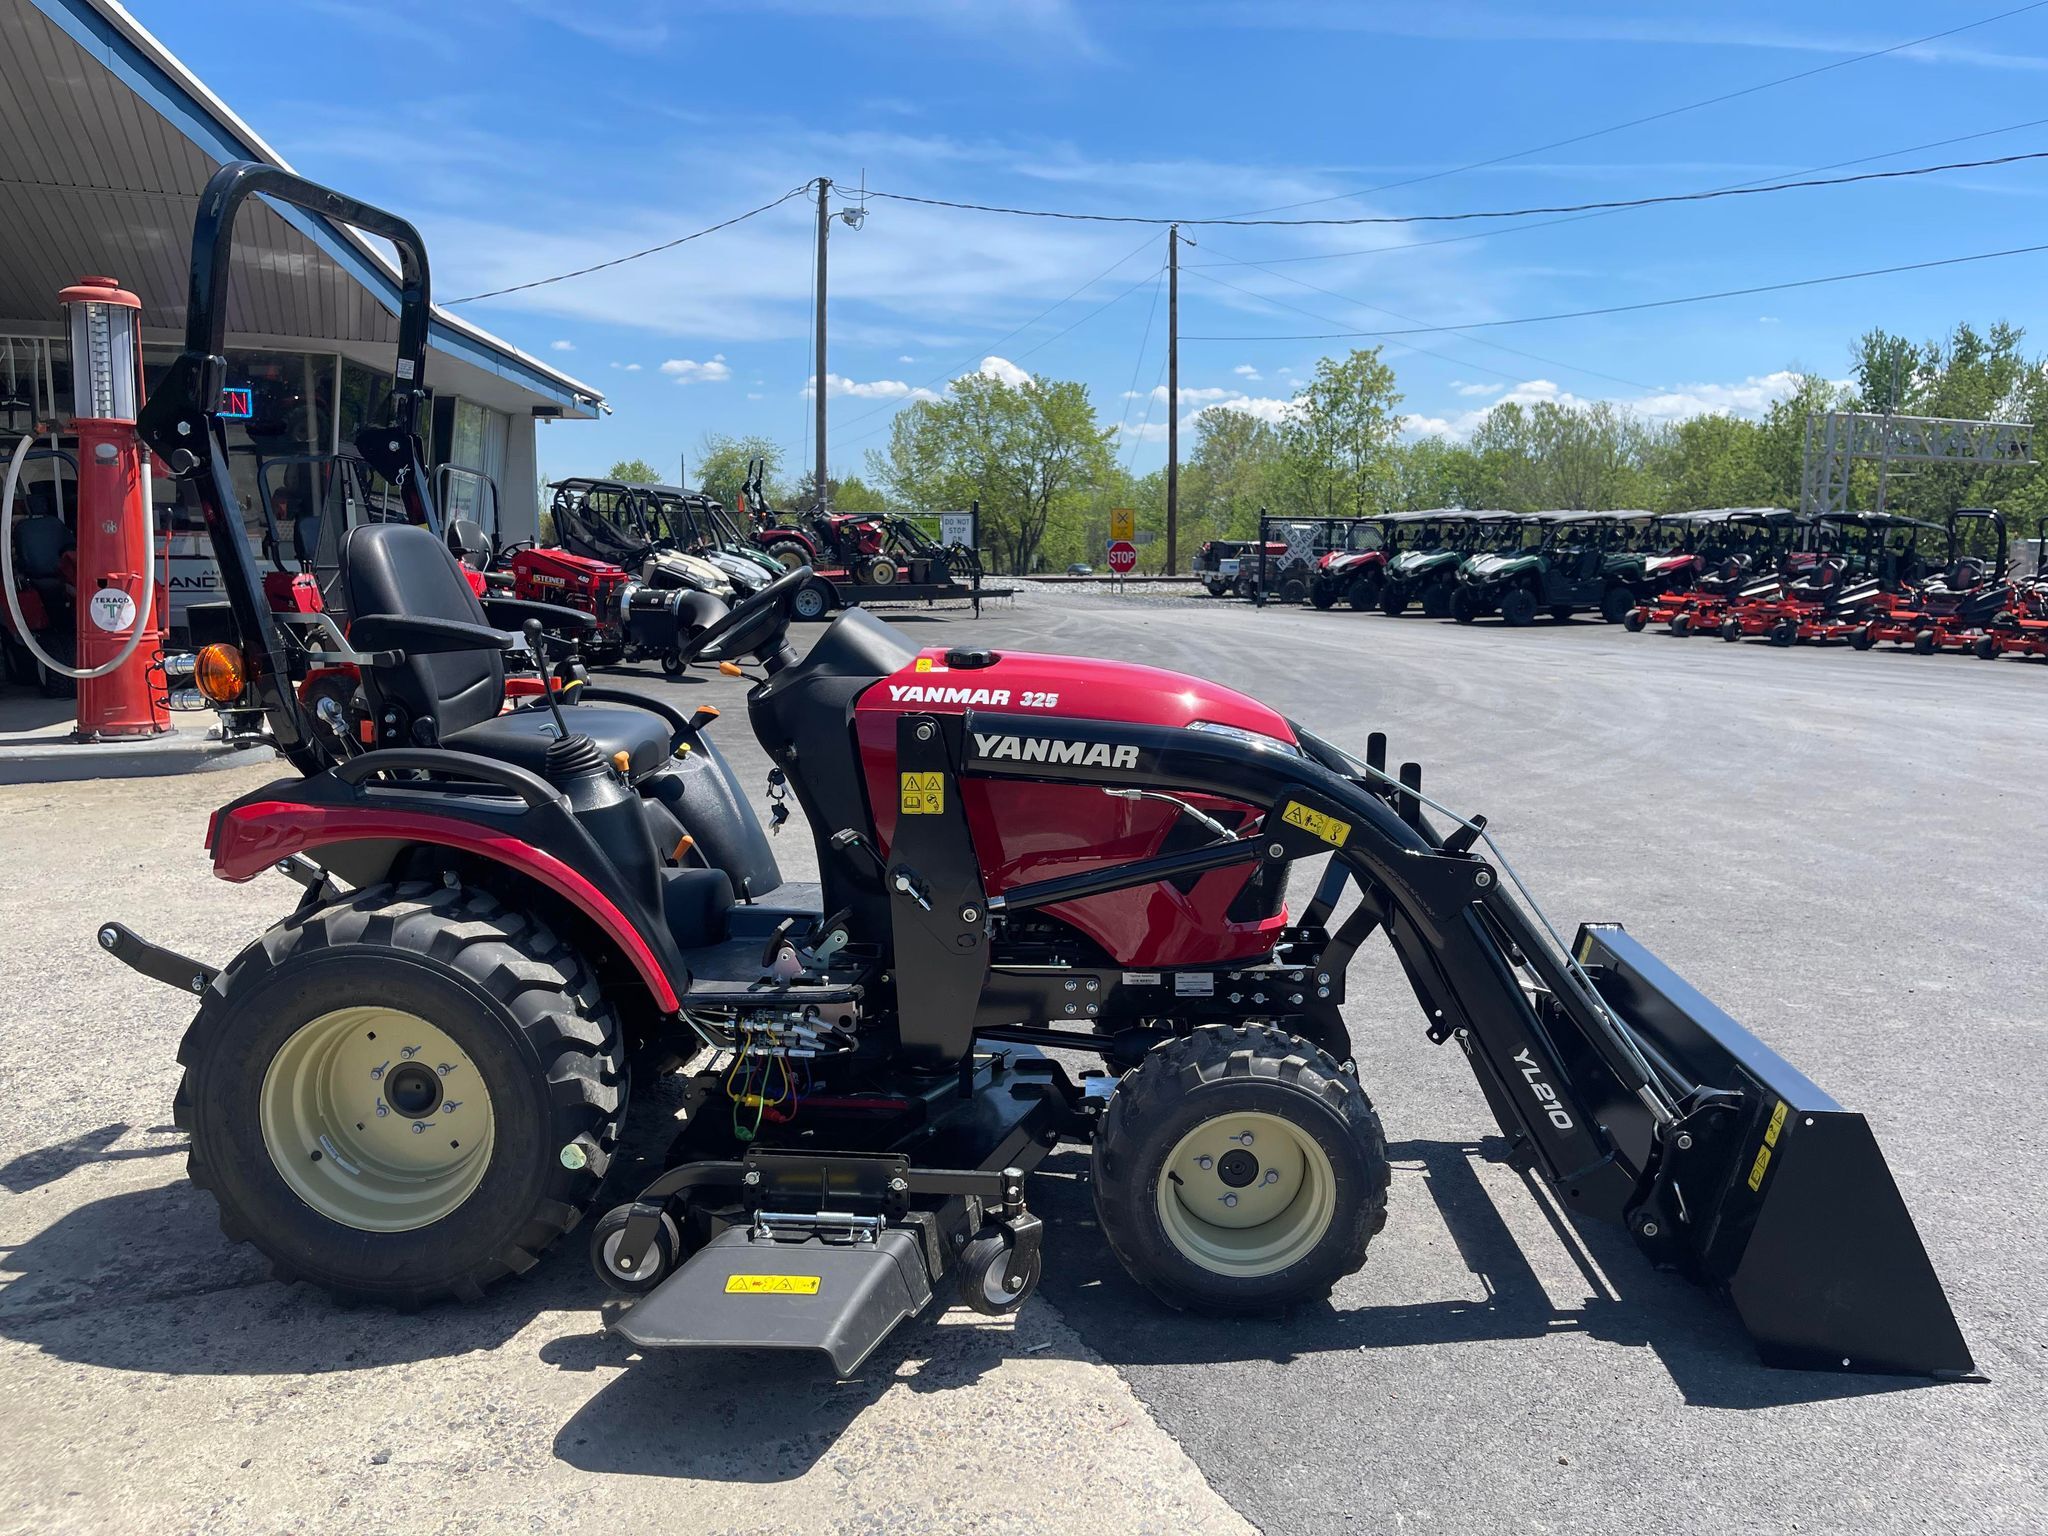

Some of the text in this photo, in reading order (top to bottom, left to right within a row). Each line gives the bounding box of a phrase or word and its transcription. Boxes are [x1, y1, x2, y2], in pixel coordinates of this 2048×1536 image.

[945, 518, 970, 526] DO NOT
[1110, 551, 1135, 564] STOP
[535, 574, 566, 585] STEINER
[888, 685, 1059, 708] YANMAR 325
[973, 733, 1140, 769] YANMAR
[1513, 1047, 1574, 1129] YL210
